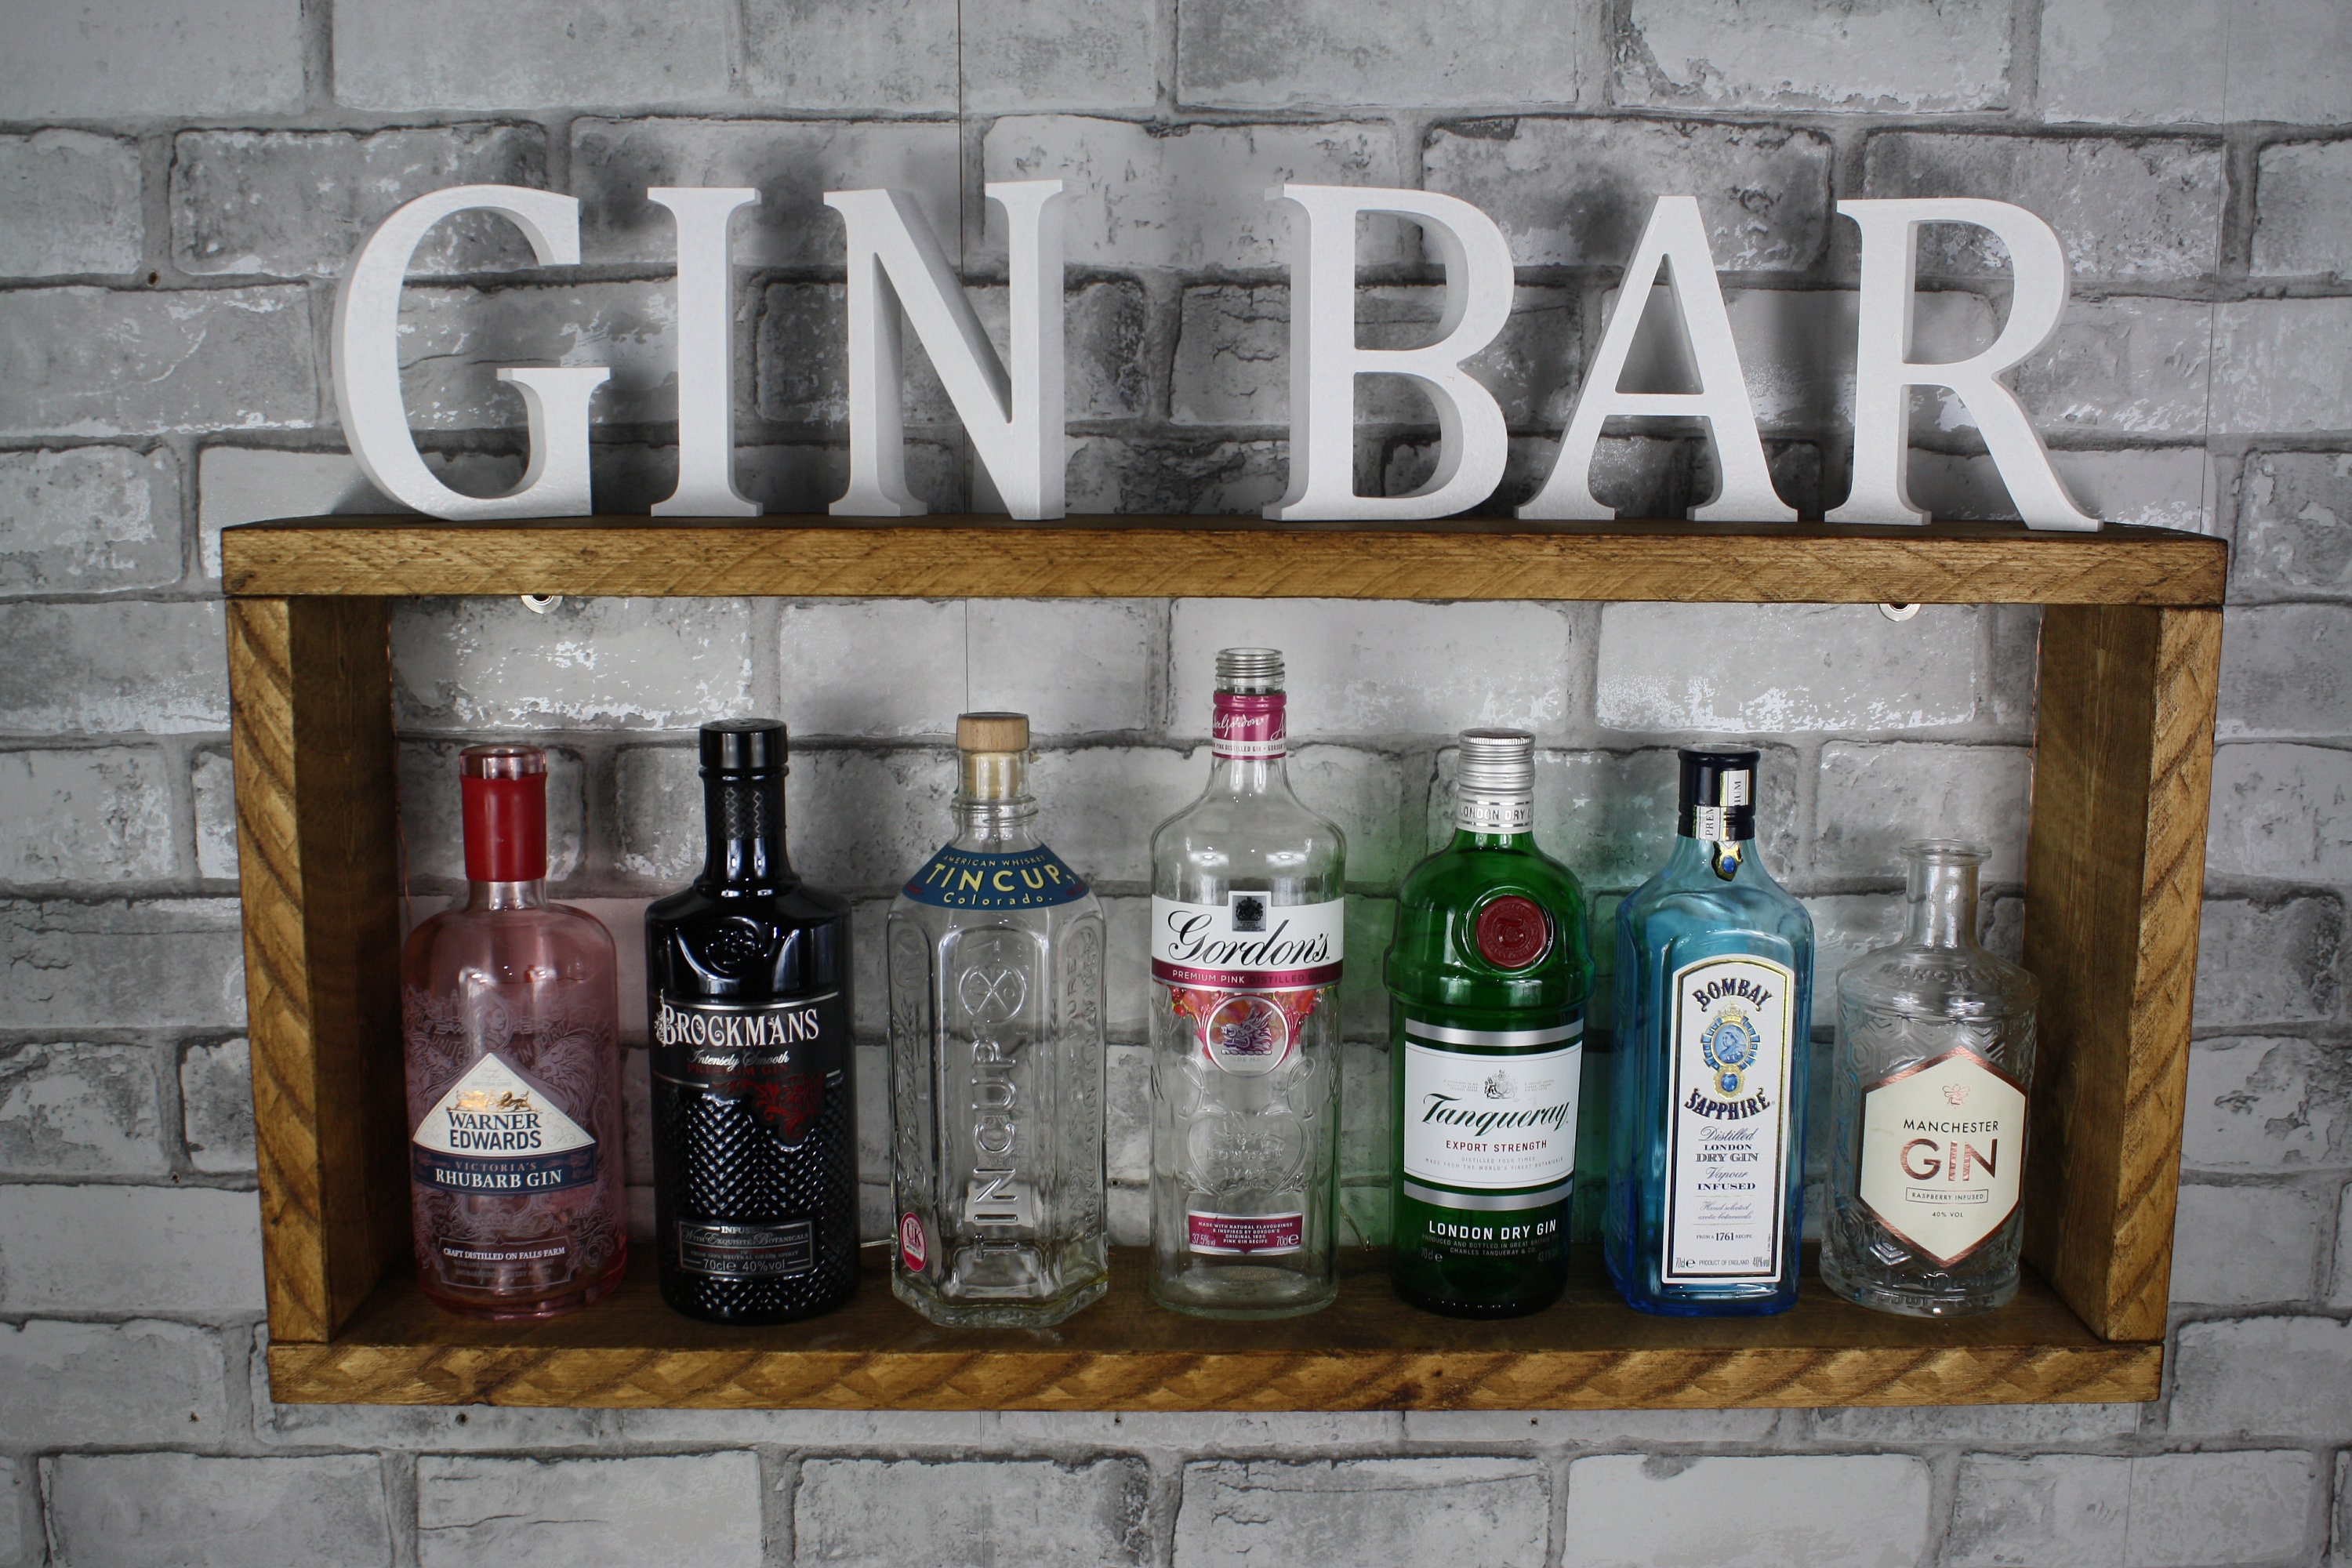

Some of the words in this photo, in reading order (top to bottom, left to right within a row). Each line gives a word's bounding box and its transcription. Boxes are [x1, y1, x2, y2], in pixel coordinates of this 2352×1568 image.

[331, 180, 1065, 522] GIN
[1263, 183, 2104, 532] BAR
[1504, 809, 1526, 821] DRY
[943, 891, 1053, 906] Colorado.
[1167, 910, 1330, 967] Gordon's
[1172, 969, 1217, 982] PREMIUM
[1220, 975, 1245, 984] PINK
[1250, 975, 1305, 985] DISTILLED
[1692, 977, 1773, 1012] BOMBAY
[655, 989, 819, 1047] BROCKMANS
[1683, 1087, 1770, 1120] SAPPHIRE
[448, 1110, 542, 1131] WARNER
[1421, 1093, 1570, 1137] Tanqueray
[1697, 1126, 1759, 1142] Distilled
[1903, 1118, 1999, 1134] MANCHESTER
[449, 1129, 543, 1150] EDWARDS
[1446, 1140, 1488, 1152] EXPORT
[1494, 1139, 1548, 1153] STRENGTH
[1696, 1152, 1729, 1163] DRY
[1730, 1152, 1759, 1162] GIN
[1900, 1138, 1998, 1181] GIN
[456, 1160, 537, 1172] VICTORIA'S
[1705, 1167, 1748, 1181] Vapour
[435, 1168, 521, 1189] RHUBARB
[526, 1169, 563, 1186] GIN
[1697, 1182, 1755, 1191] INFUSED
[1911, 1192, 1952, 1201] RASPBERRY
[720, 1225, 765, 1235] INFUSED
[1428, 1220, 1493, 1240] LONDON
[1501, 1225, 1530, 1240] DRY
[1537, 1219, 1556, 1236] GIN
[1715, 1232, 1734, 1241] 1761
[443, 1247, 463, 1258] CRAFT
[465, 1250, 503, 1261] DISTILLED
[519, 1250, 543, 1259] FALLS
[543, 1247, 565, 1257] FARM
